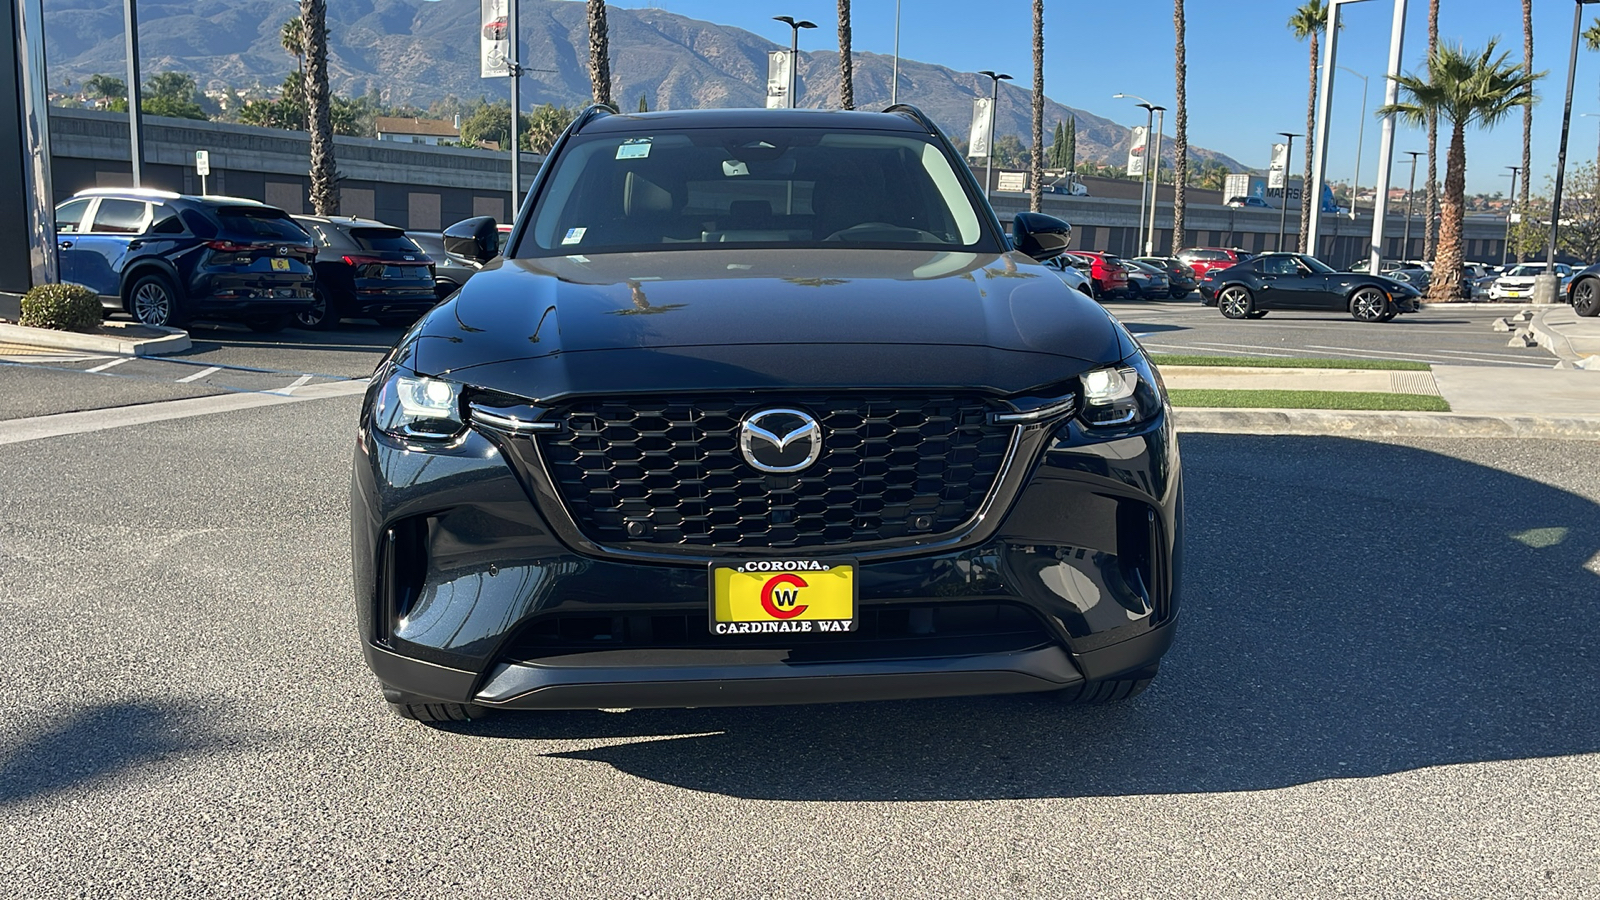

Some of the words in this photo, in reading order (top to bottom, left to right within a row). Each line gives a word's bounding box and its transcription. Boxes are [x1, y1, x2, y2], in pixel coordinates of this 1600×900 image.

[745, 560, 822, 571] CORONA
[775, 589, 798, 606] W
[715, 621, 812, 634] CARDINALE
[818, 620, 853, 632] WAY
